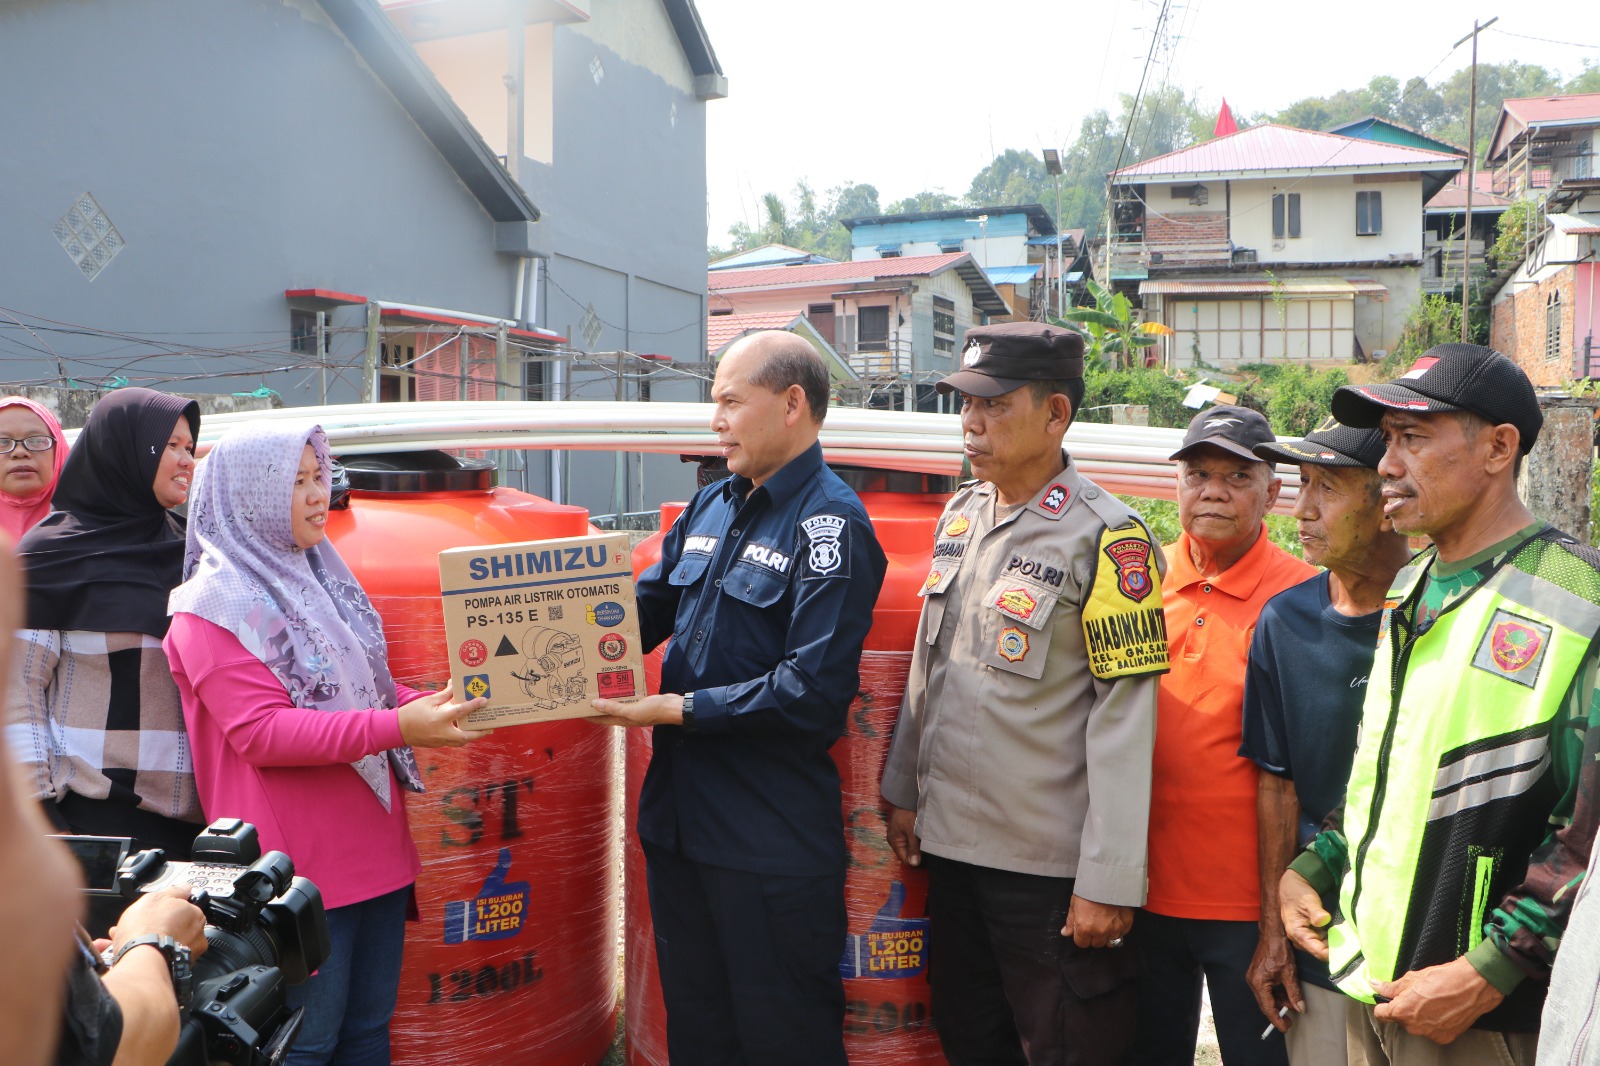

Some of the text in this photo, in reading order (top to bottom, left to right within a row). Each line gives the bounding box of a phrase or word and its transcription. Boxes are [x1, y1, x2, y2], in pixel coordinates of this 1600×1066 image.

[806, 517, 840, 530] POLDA
[469, 544, 607, 581] SHIMIZU
[743, 544, 790, 573] POLRI
[1007, 555, 1065, 588] POLRI
[464, 583, 620, 610] POMPA AIR LISTRIK OTOMATIS
[466, 609, 539, 628] PS-135 E
[469, 646, 478, 658] 3
[1092, 653, 1118, 665] KEL.
[1095, 663, 1113, 675] KEC.
[476, 892, 524, 906] ISI BUJURAN
[476, 901, 523, 920] 1.200
[475, 916, 520, 934] LITER
[868, 930, 924, 941] ISI BUJURAN
[868, 938, 923, 956] 1.200
[869, 955, 921, 972] LITER
